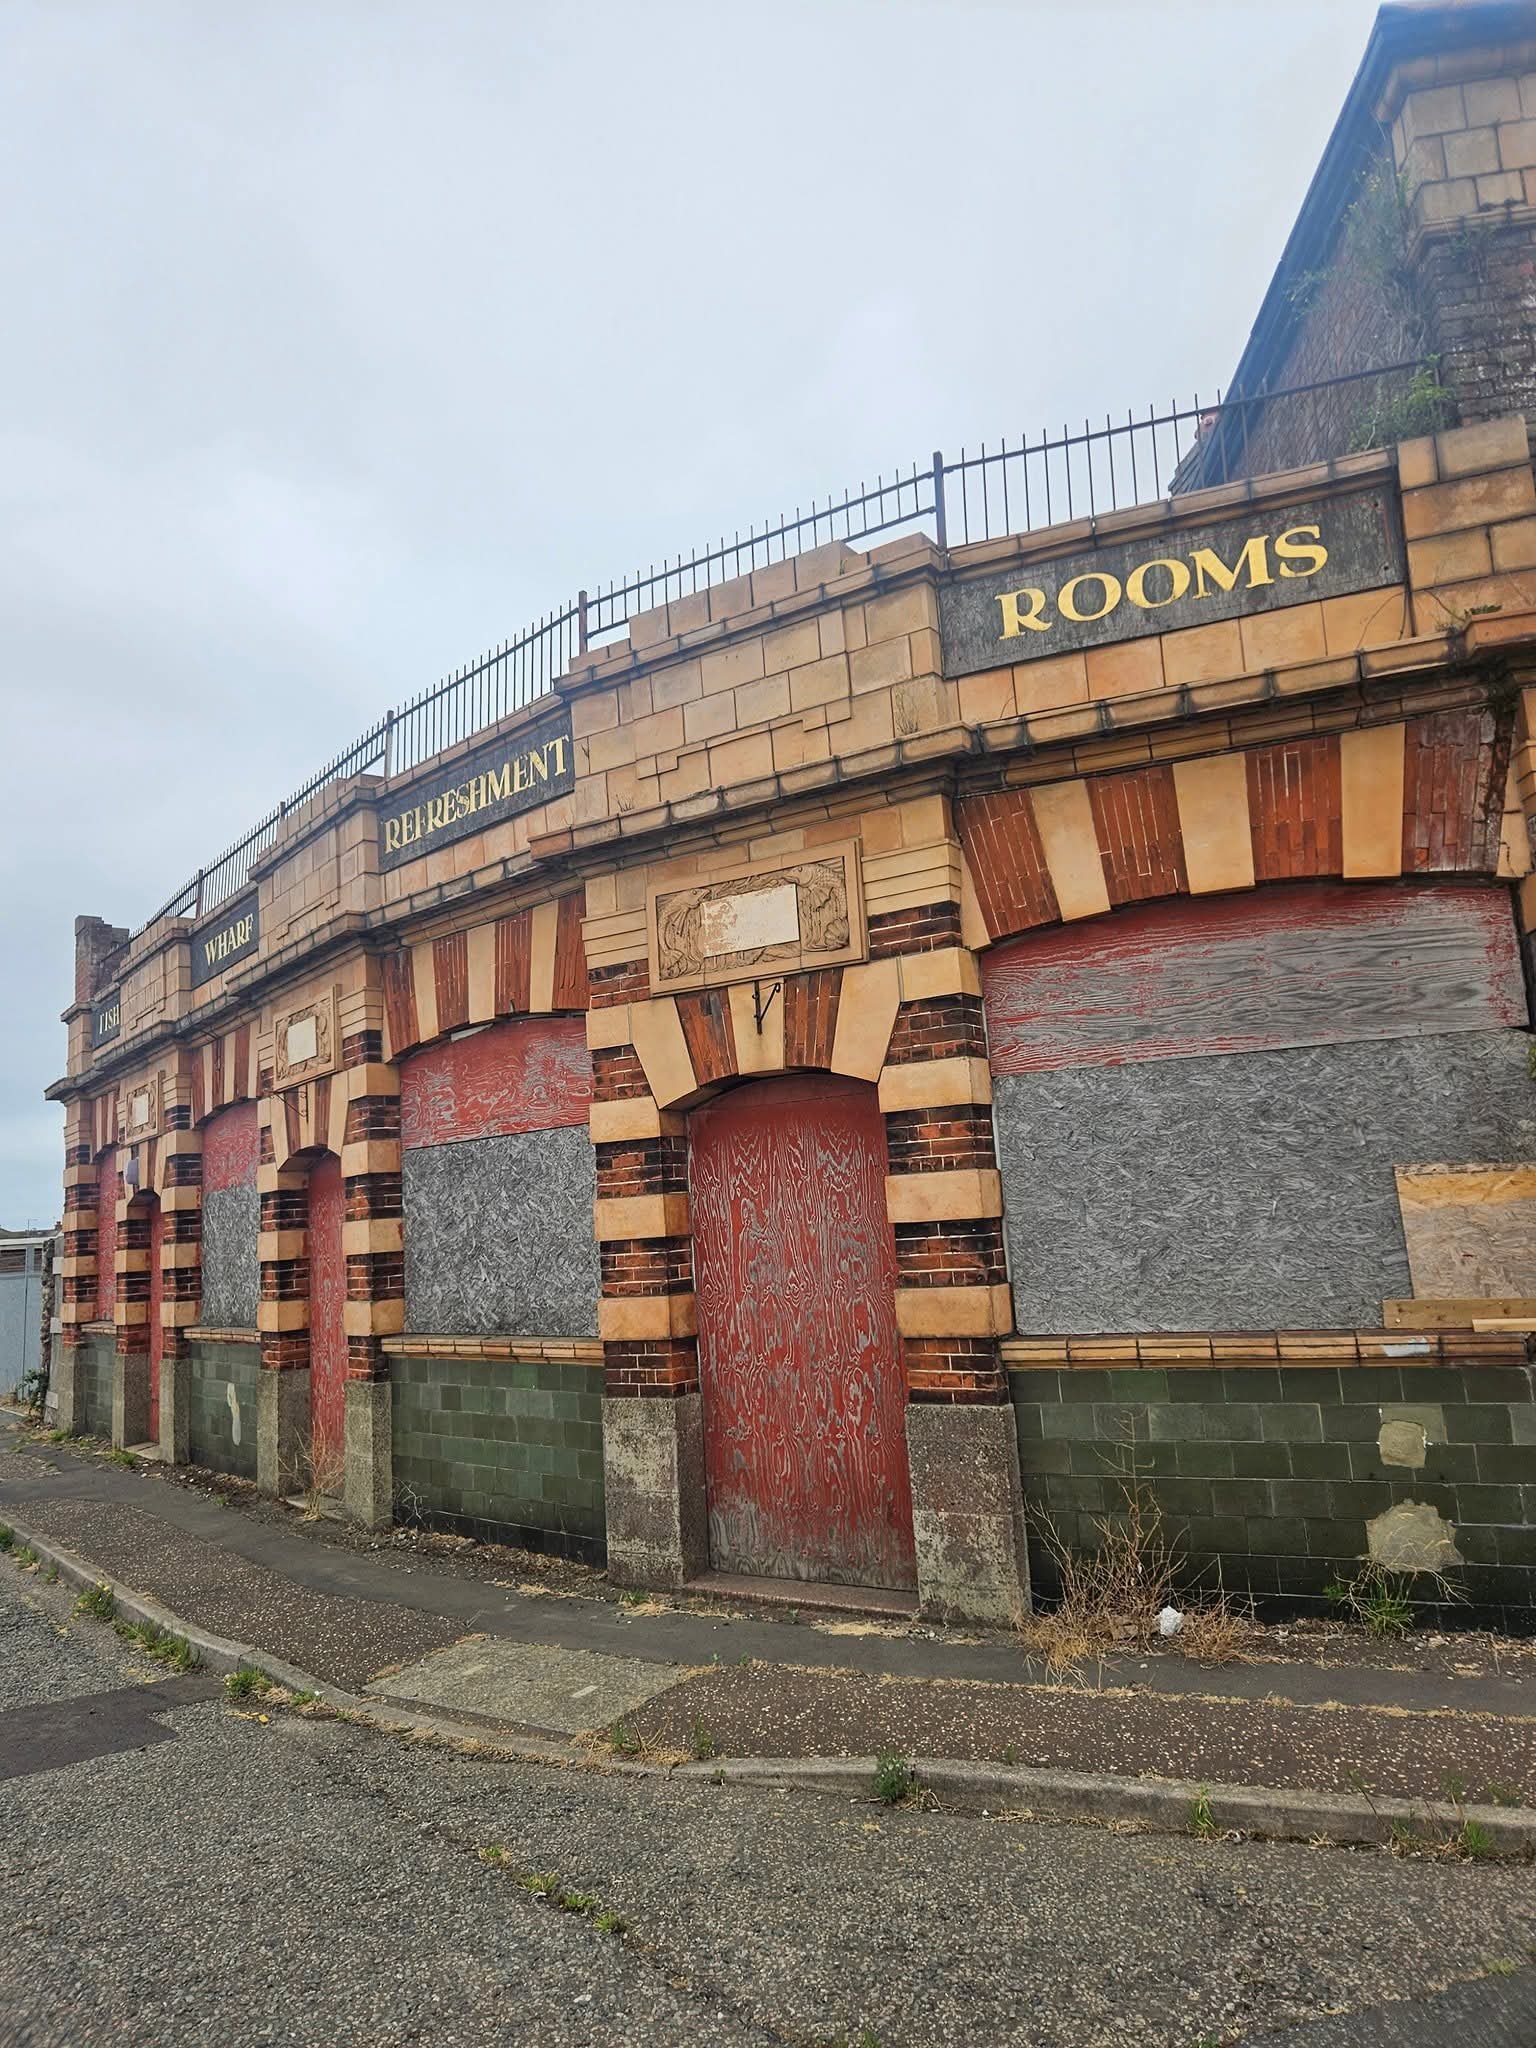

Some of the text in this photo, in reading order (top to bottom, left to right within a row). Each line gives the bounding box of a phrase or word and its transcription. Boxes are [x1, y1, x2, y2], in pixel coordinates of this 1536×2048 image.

[994, 524, 1329, 640] ROOMS
[384, 734, 570, 854] REFRESHMENT
[204, 913, 254, 967] WHARF
